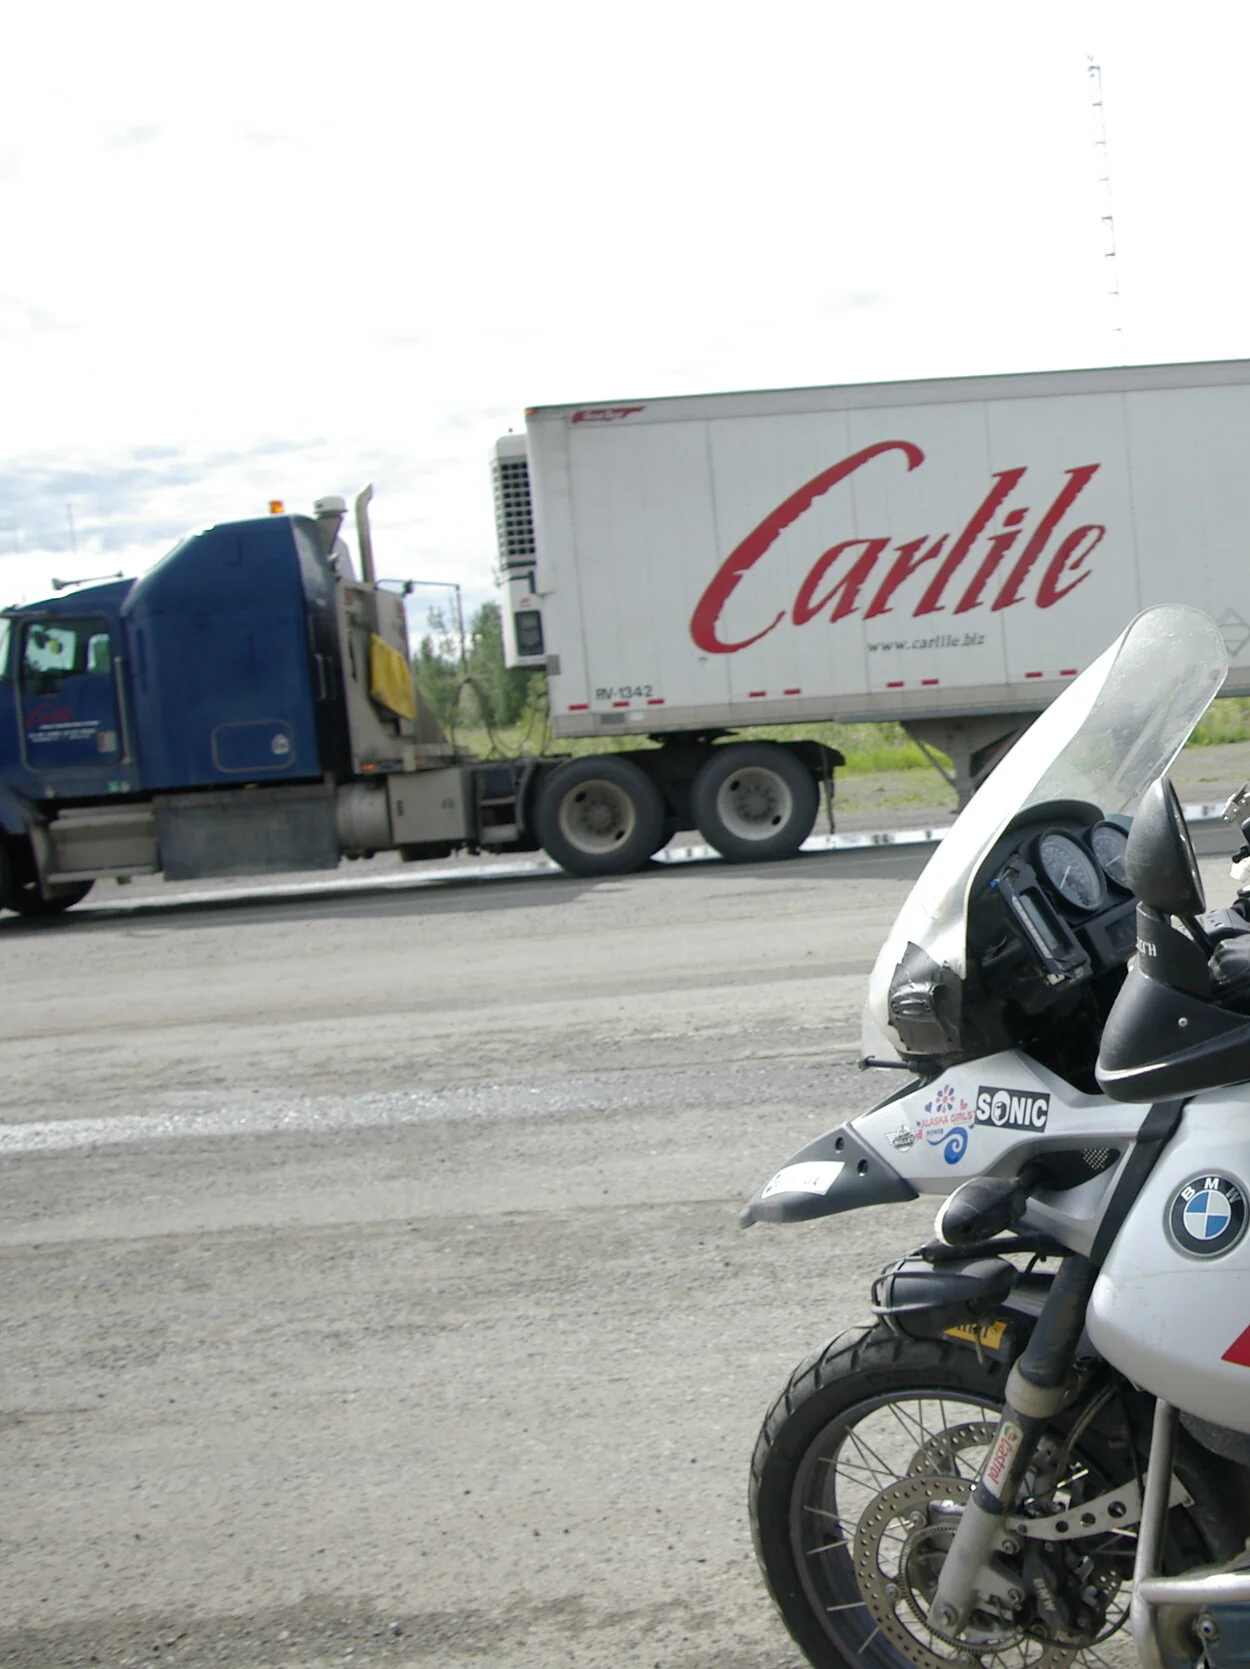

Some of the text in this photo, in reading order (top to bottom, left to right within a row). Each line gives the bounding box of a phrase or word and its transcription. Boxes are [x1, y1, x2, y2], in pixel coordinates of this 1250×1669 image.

[690, 440, 1107, 654] Carlile
[868, 632, 986, 652] www.carlile.biz
[596, 684, 653, 700] RV-1342
[976, 1089, 1048, 1127] SONIC
[1181, 1177, 1242, 1203] BMW
[988, 1435, 1013, 1485] Castrol
[1033, 1578, 1056, 1612] BMW
